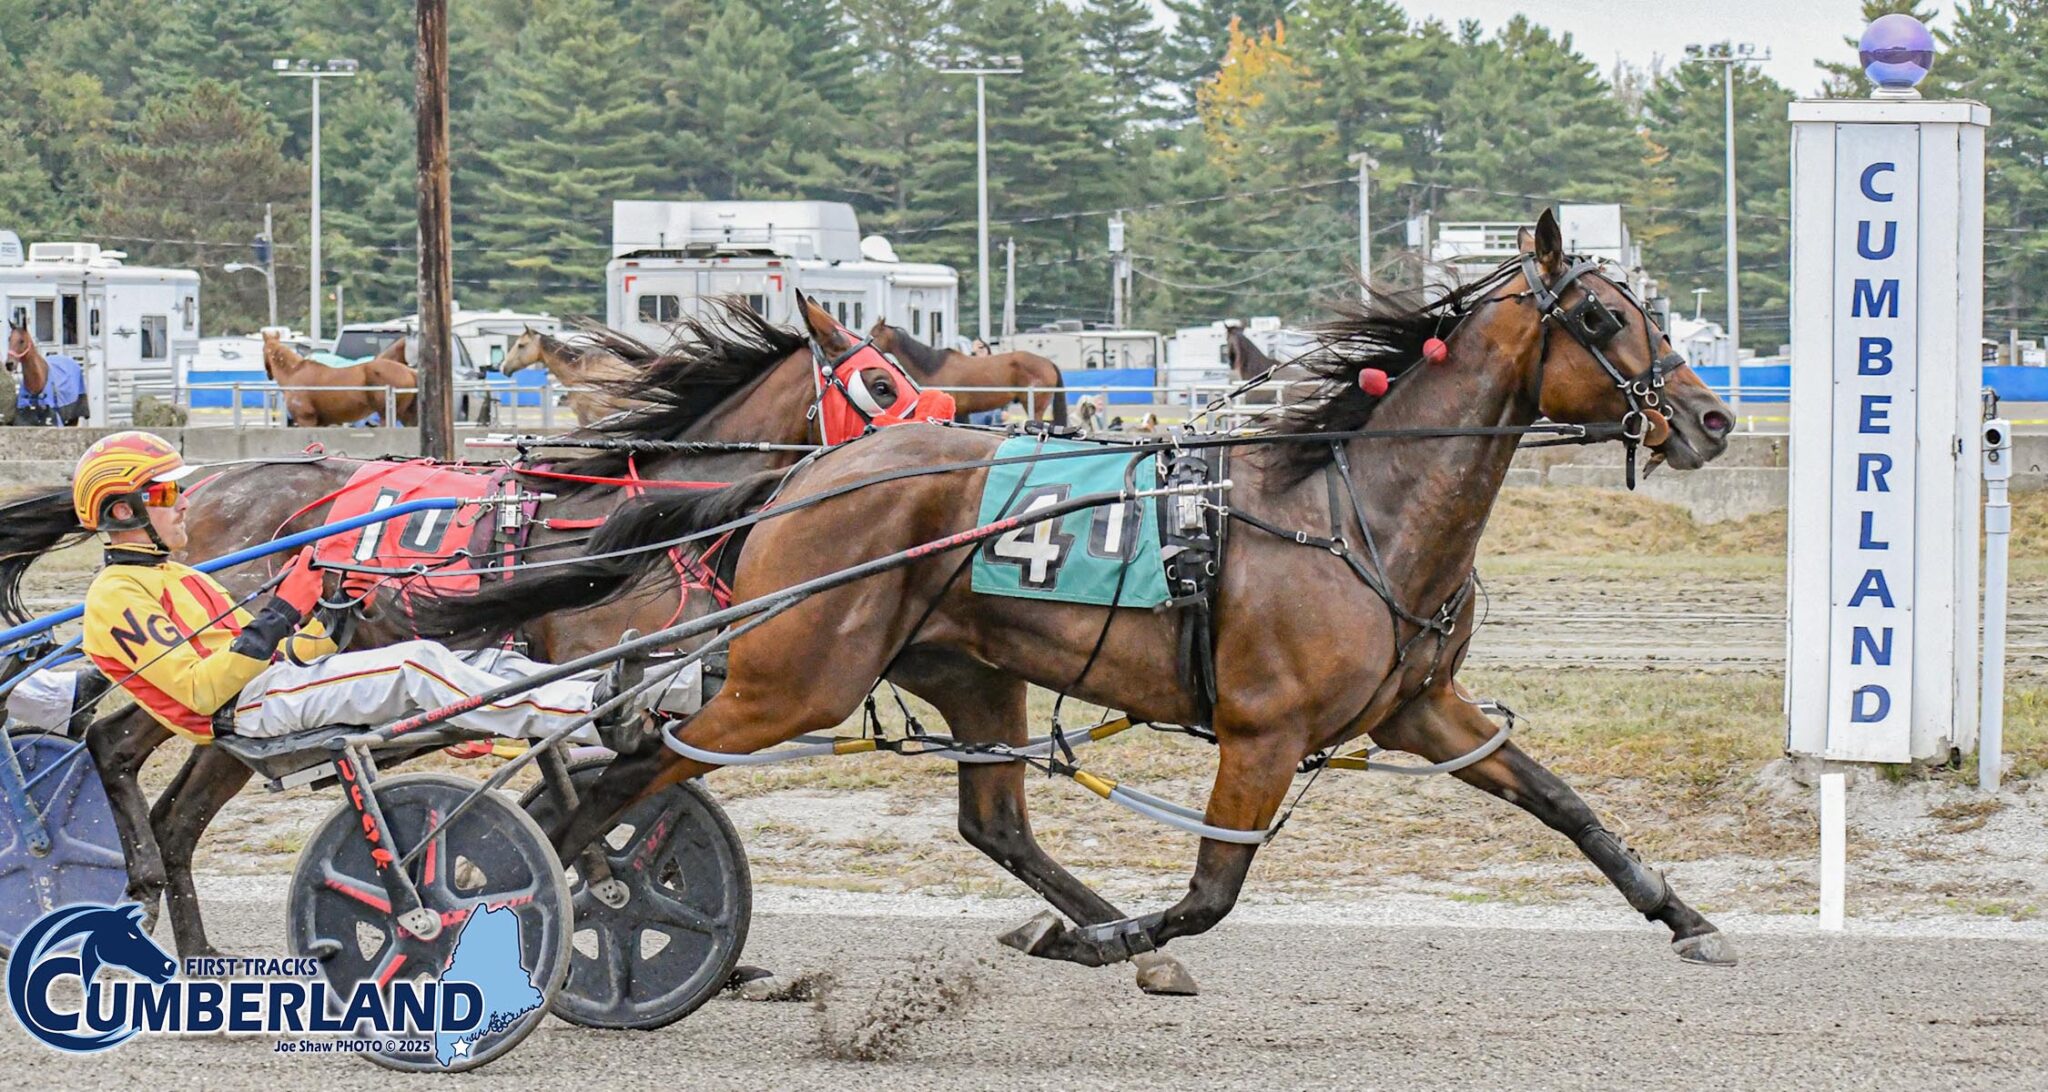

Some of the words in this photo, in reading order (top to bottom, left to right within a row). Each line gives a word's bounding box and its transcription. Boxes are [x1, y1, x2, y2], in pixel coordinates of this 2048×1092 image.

[1847, 161, 1900, 723] CUMBERLAND
[110, 607, 183, 664] NG
[391, 718, 422, 735] NICK
